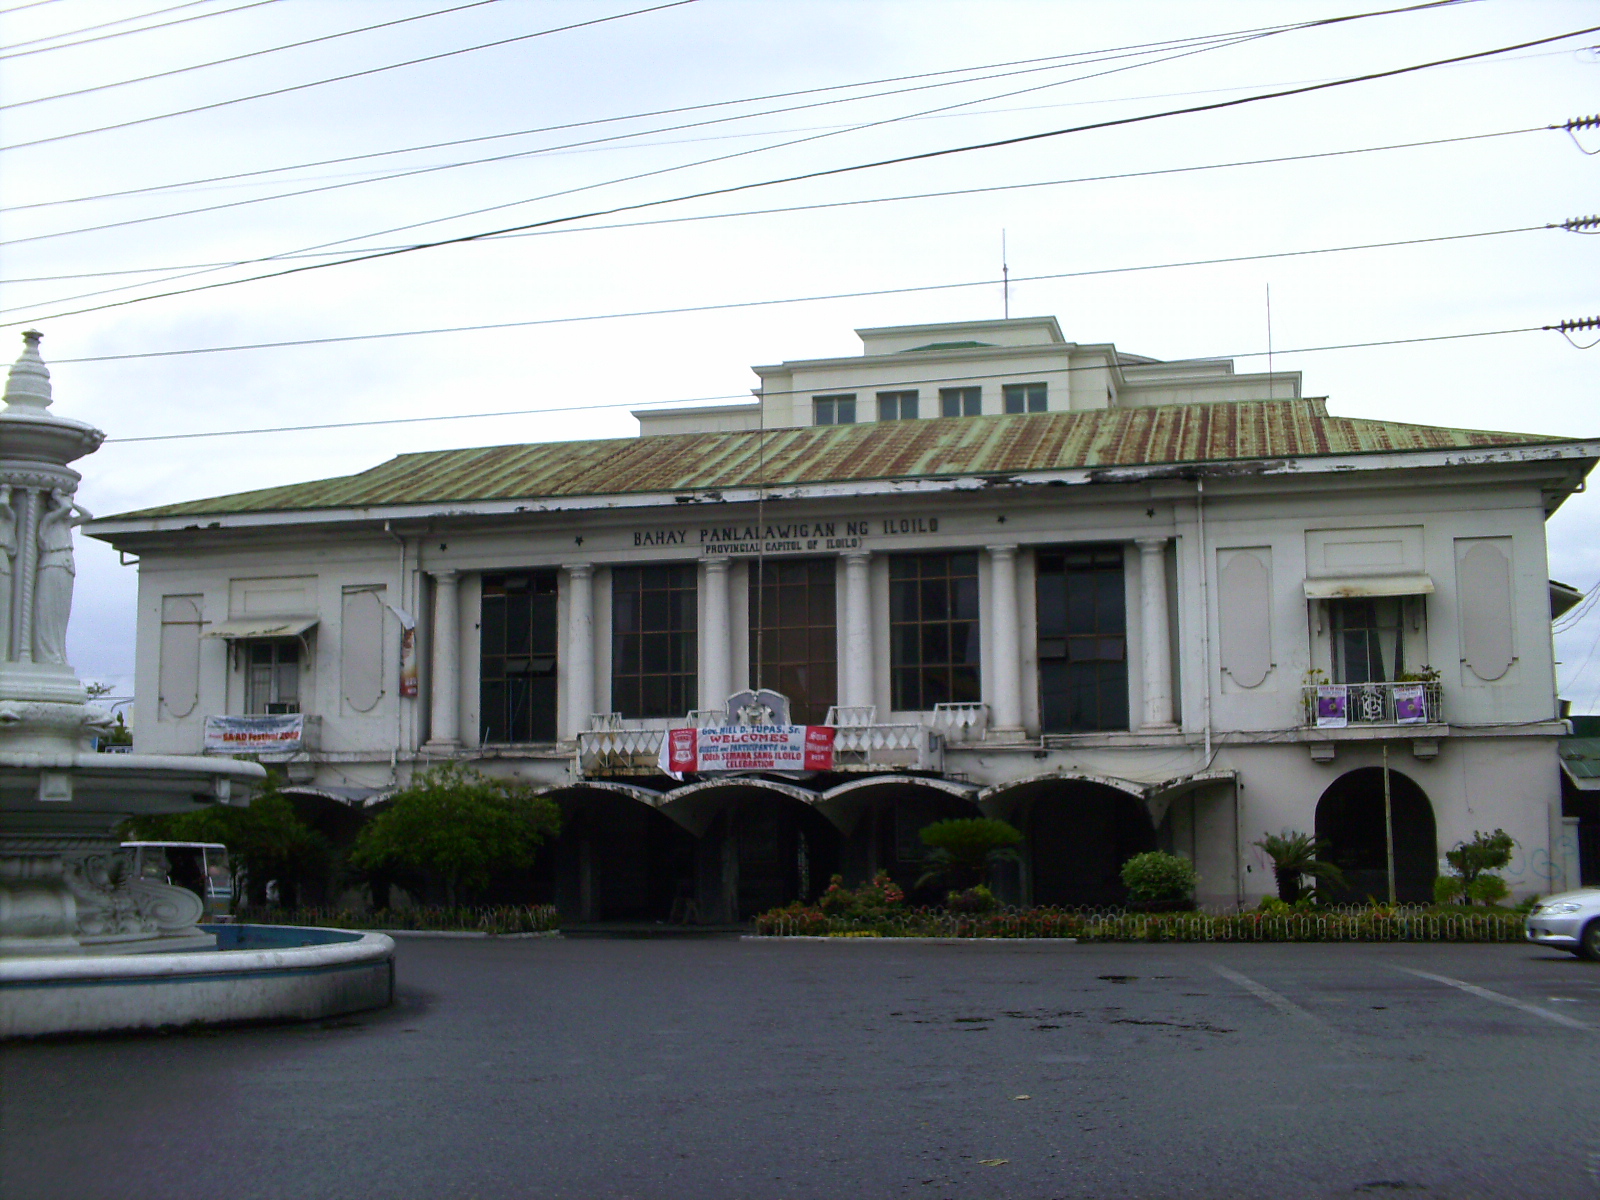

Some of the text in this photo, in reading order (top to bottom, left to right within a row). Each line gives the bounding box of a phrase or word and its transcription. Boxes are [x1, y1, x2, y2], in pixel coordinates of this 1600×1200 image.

[634, 517, 938, 545] BAHAY PANLALAWIGAN NG ILOILO
[765, 540, 802, 551] CAPITOL
[807, 539, 818, 550] OF
[710, 733, 789, 743] WELCOMES
[721, 752, 752, 760] SEMANA
[775, 752, 802, 760] ILOILO
[726, 760, 774, 768] CELEBRATION
